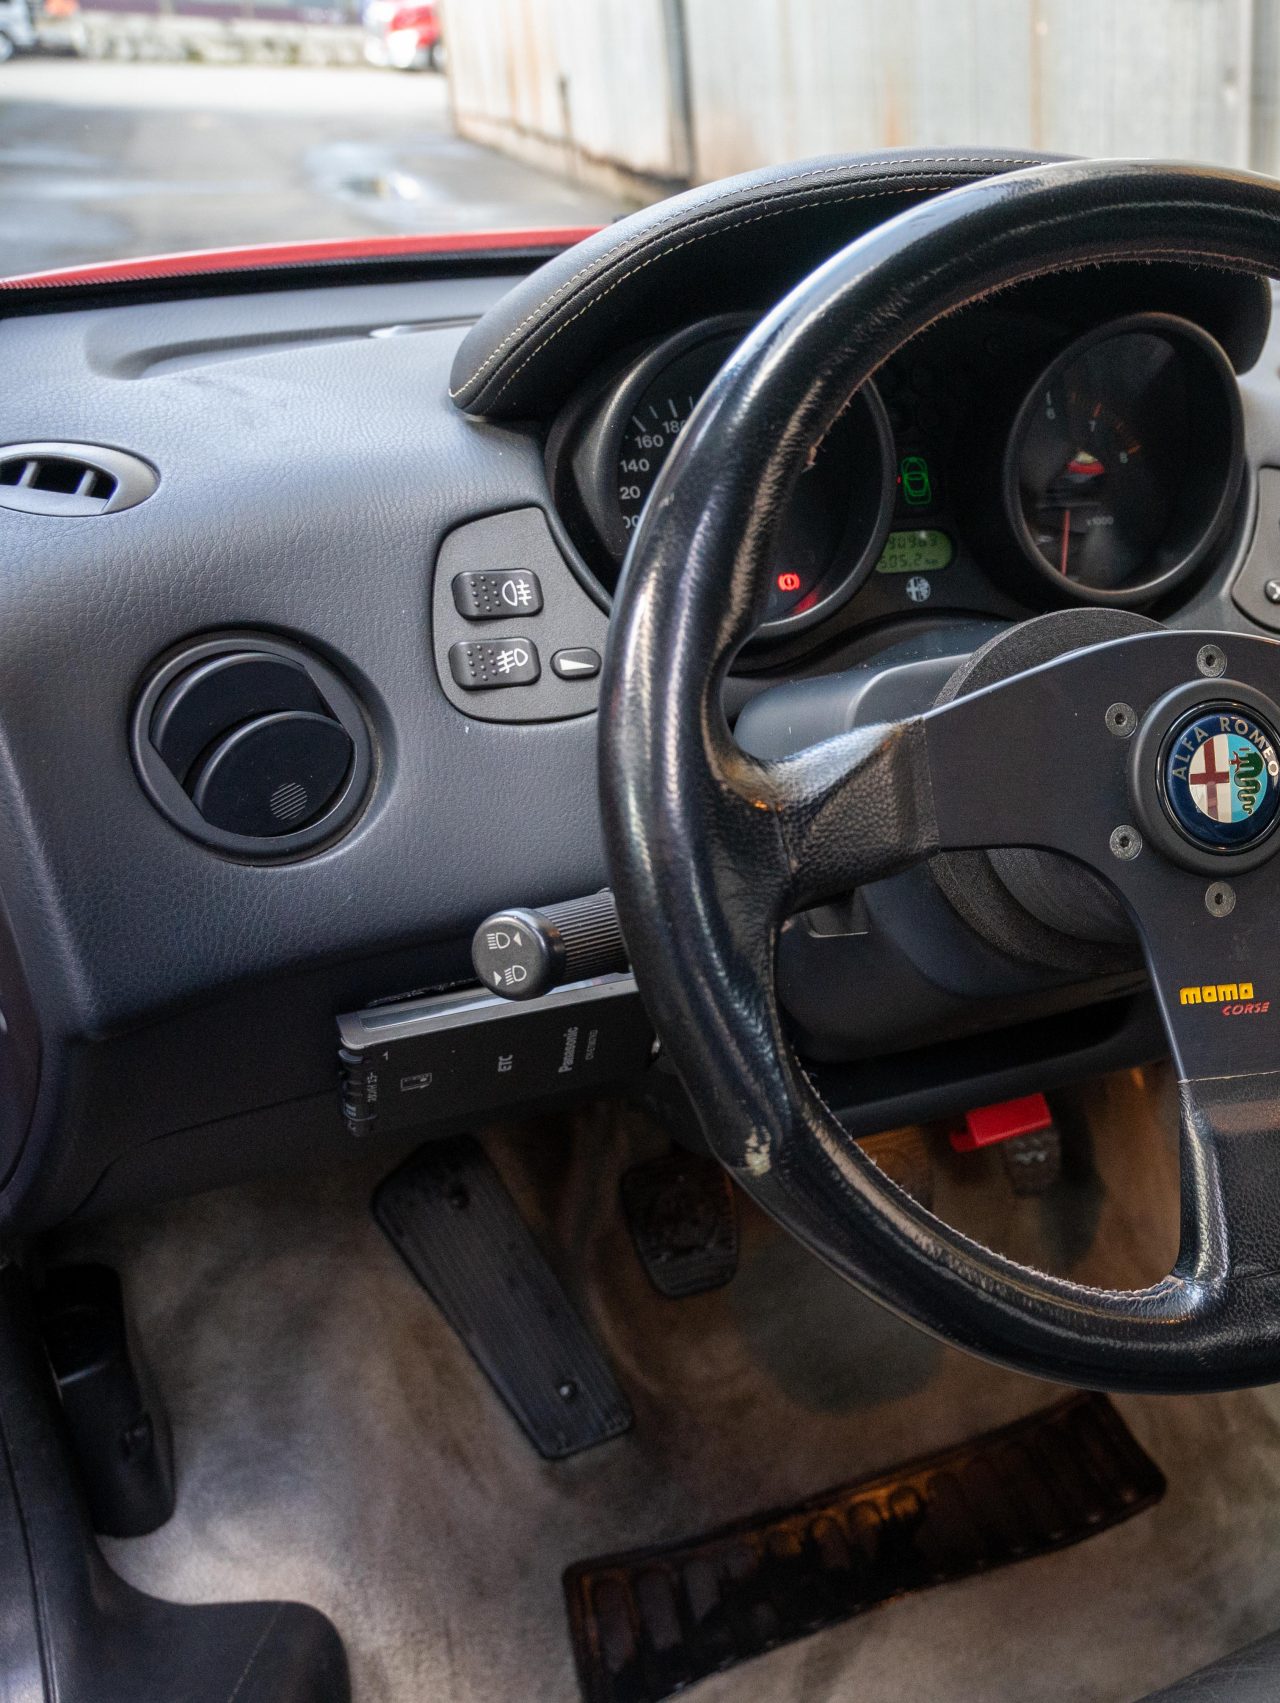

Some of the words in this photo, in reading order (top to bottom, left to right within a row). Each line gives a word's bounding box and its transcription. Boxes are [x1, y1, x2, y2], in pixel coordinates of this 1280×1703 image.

[634, 434, 664, 449] 160
[620, 458, 650, 473] 140
[620, 485, 641, 500] 20
[1172, 726, 1208, 781] ALFA
[1220, 717, 1279, 777] ROMEO
[1222, 1001, 1270, 1016] CORSE
[558, 1026, 578, 1073] Panasonic
[497, 1054, 513, 1073] ETC
